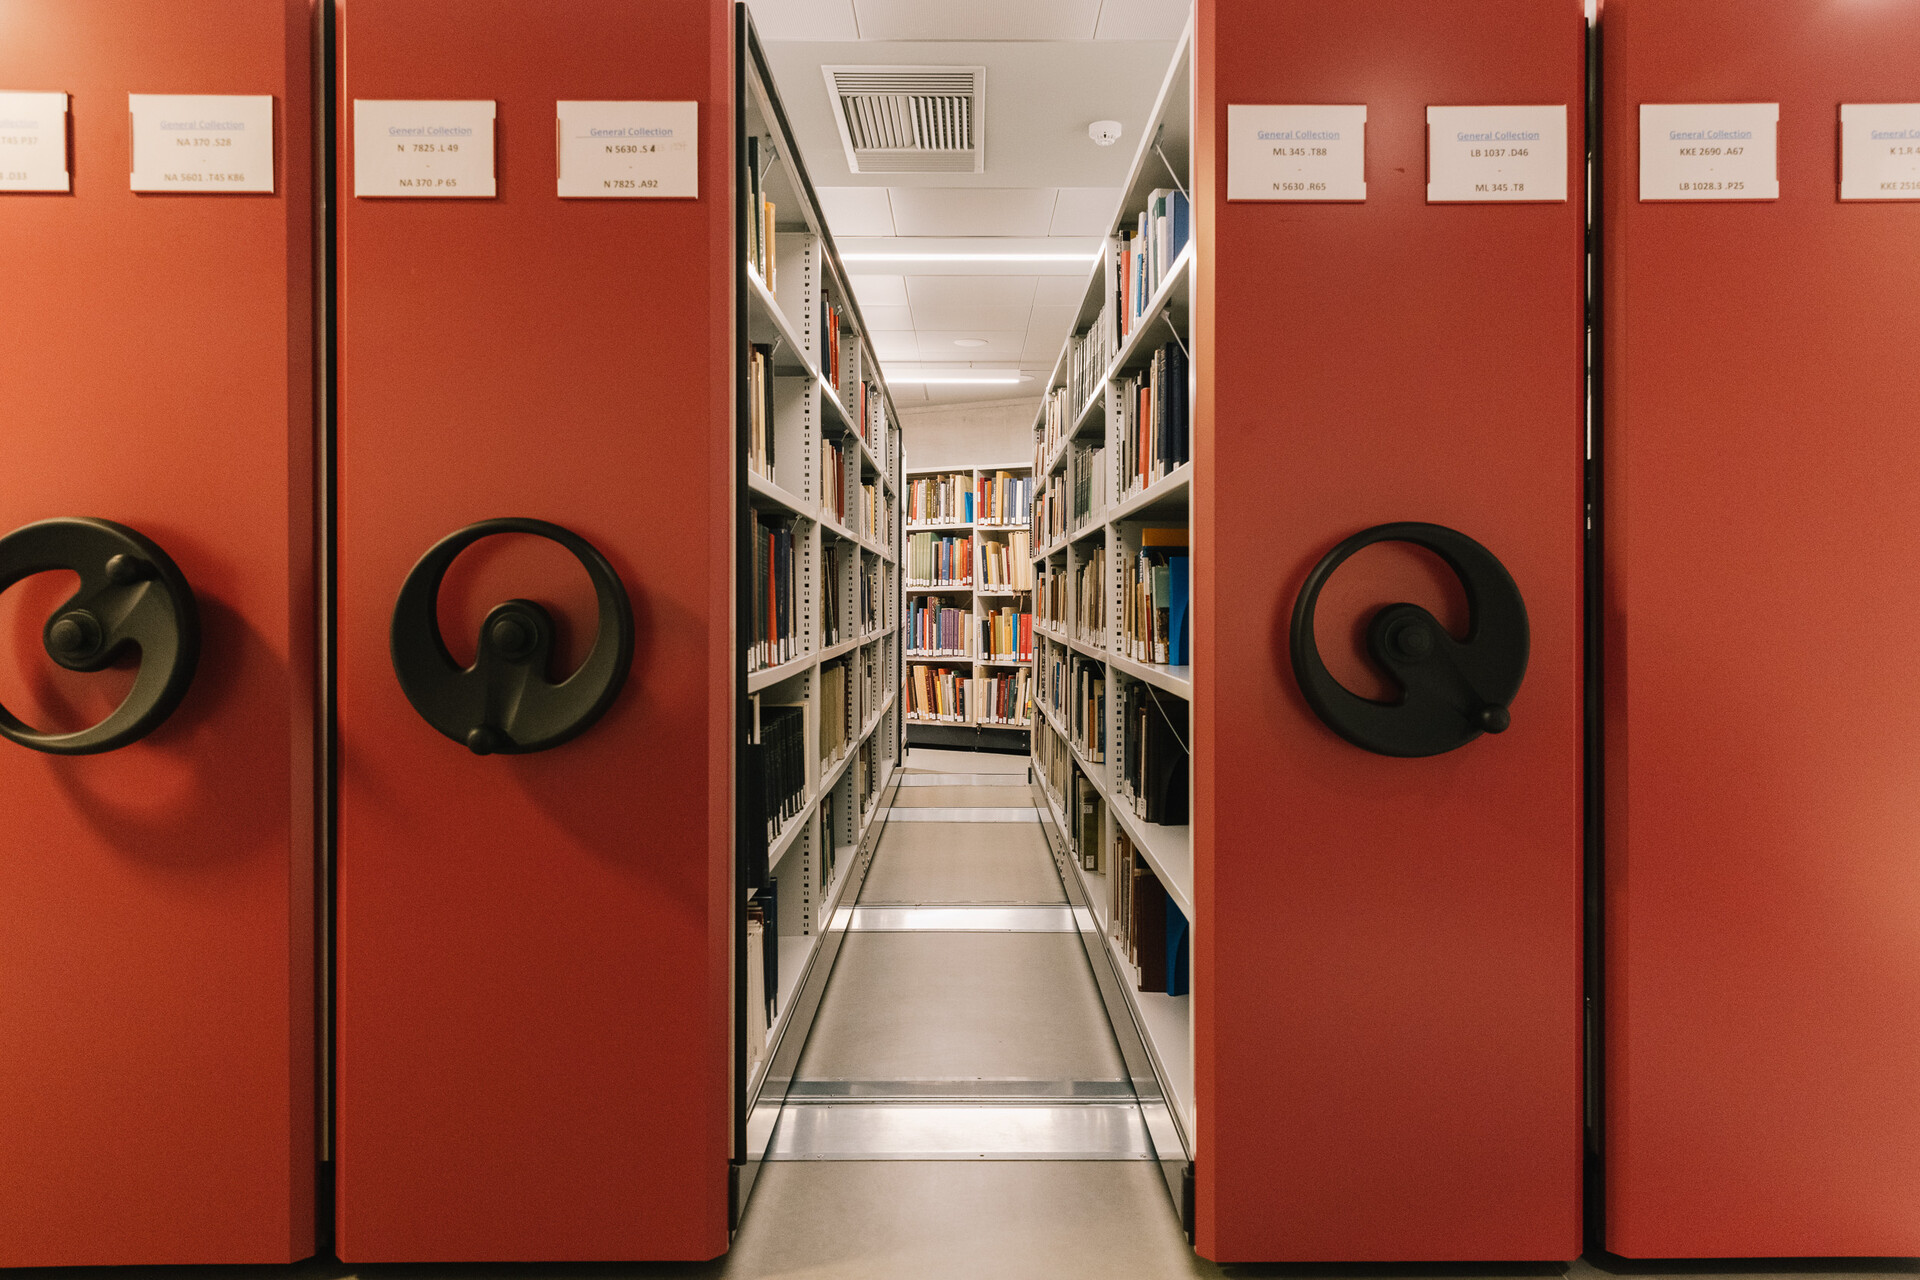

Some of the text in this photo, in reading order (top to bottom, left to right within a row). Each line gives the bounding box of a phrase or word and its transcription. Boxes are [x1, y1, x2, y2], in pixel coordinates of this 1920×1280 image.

[160, 120, 245, 130] General Collection
[388, 126, 472, 136] General Collection
[590, 127, 673, 137] General Collection
[1257, 130, 1340, 140] General Collection
[1669, 130, 1752, 140] General Collection
[1871, 130, 1907, 139] General
[1457, 131, 1540, 141] General Collection
[176, 138, 190, 146] NA
[193, 138, 210, 146] 370
[397, 144, 404, 152] N
[413, 144, 435, 152] 7825
[447, 144, 459, 152] 49
[606, 145, 612, 153] N
[615, 145, 637, 153] 5630
[1272, 148, 1327, 156] ML 345 .T88
[1470, 148, 1529, 157] LB 1037 .D46
[1680, 147, 1744, 156] KKE 2690 .A67
[1890, 147, 1896, 155] K
[165, 174, 178, 182] NA
[400, 179, 413, 187] NA
[416, 179, 432, 187] 370
[446, 179, 457, 187] 65
[604, 180, 658, 188] N 7825 .A92
[1273, 183, 1326, 191] N 5630 .R65
[1475, 183, 1524, 192] ML 345 .T8
[1679, 182, 1745, 191] LB 1028.3 .P25
[1880, 182, 1897, 190] KKE
